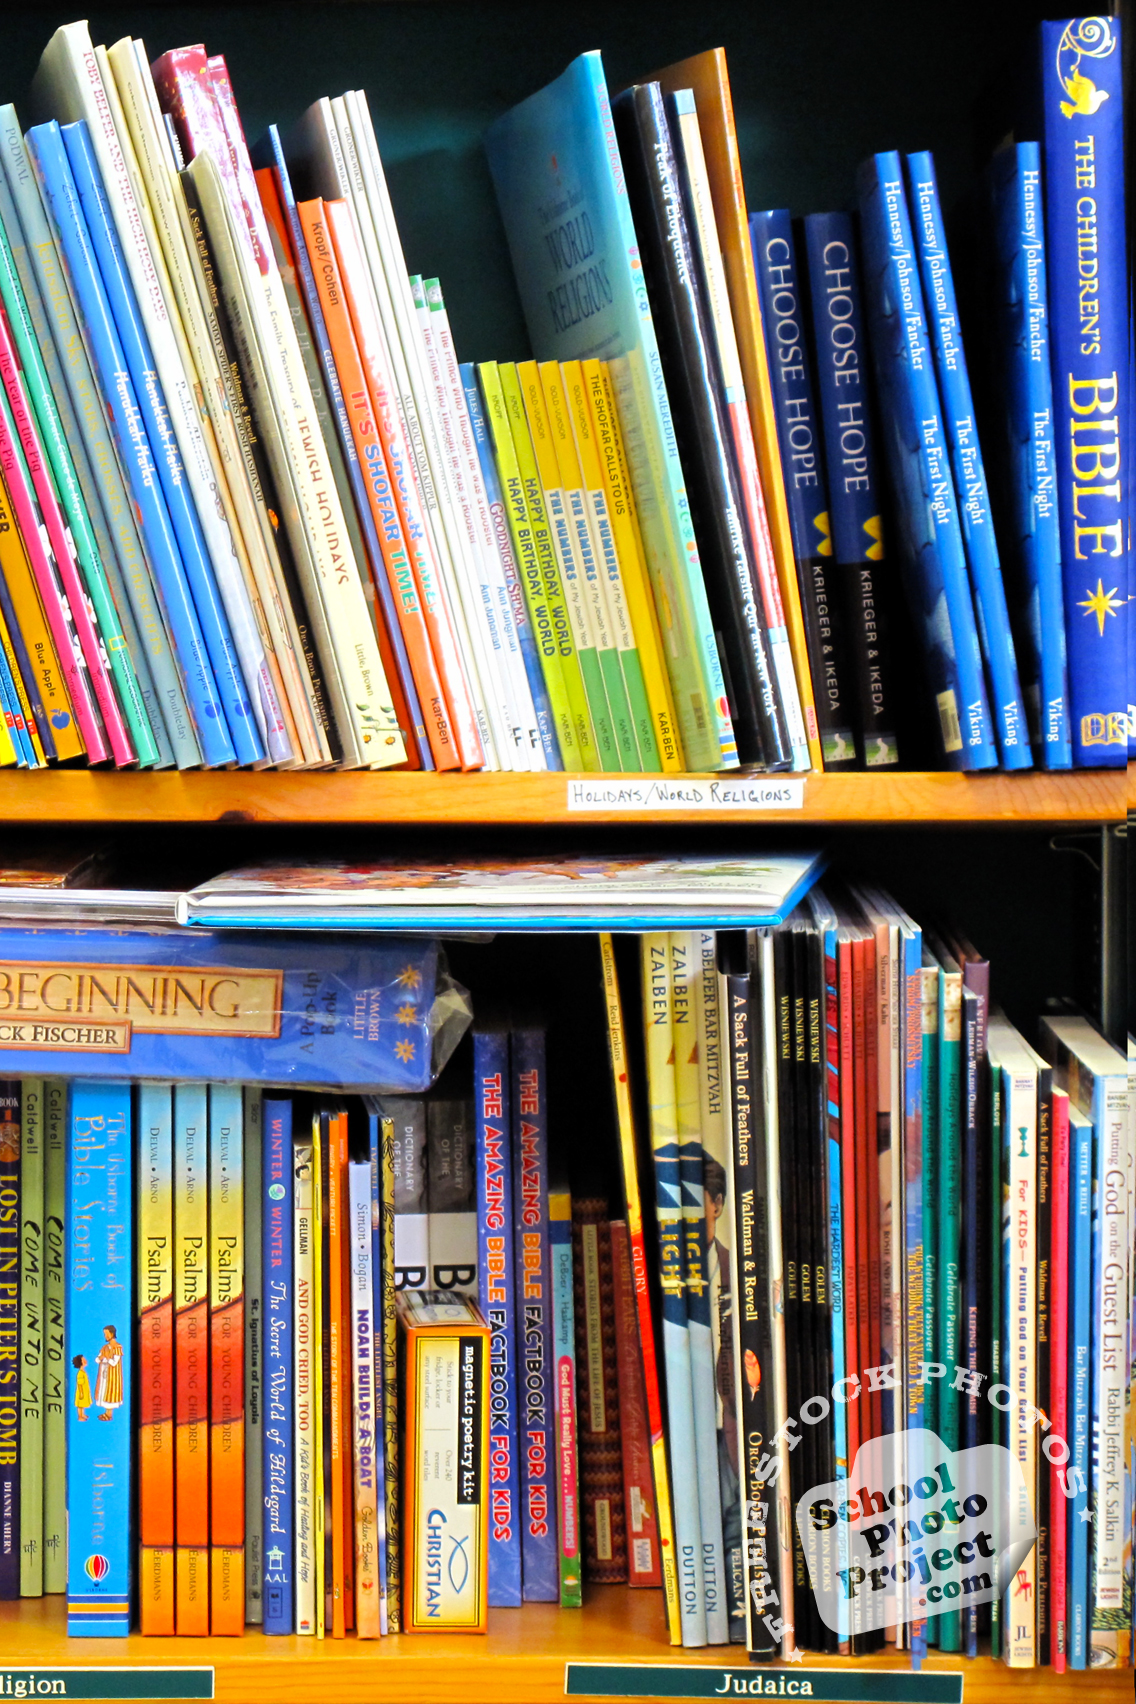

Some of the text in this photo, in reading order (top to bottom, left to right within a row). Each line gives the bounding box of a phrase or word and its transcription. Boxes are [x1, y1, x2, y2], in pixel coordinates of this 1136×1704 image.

[311, 221, 339, 307] Kropf/Cohen
[884, 180, 925, 370] Hennessy/Johnson/Fancher
[766, 237, 817, 490] CHOOSE HOPE
[1069, 135, 1122, 560] THE CHILDREN'S BIBLE
[350, 389, 420, 614] IT'S SHOFAR TIME!
[921, 415, 949, 524] The First Night
[505, 477, 556, 658] HAPPY BIRTHDAY, WORLD
[813, 565, 841, 712] KRIEGER & IKEDA
[967, 699, 982, 747] Viking
[1084, 714, 1126, 746] DK
[31, 1025, 118, 1044] FISCHER
[650, 945, 665, 1025] ZALBEN
[734, 995, 752, 1167] A Sack Full of Feathers
[270, 1120, 282, 1268] WINTER WINTER
[1103, 1122, 1126, 1372] Putting God on the Guest List
[482, 1074, 511, 1542] THE AMAZING BIBLE FACTBOOK FOR KIDS
[464, 1346, 476, 1416] magnetic
[464, 1418, 476, 1470] poetry
[682, 1546, 696, 1615] DUTTON
[716, 1674, 813, 1695] Judaica
